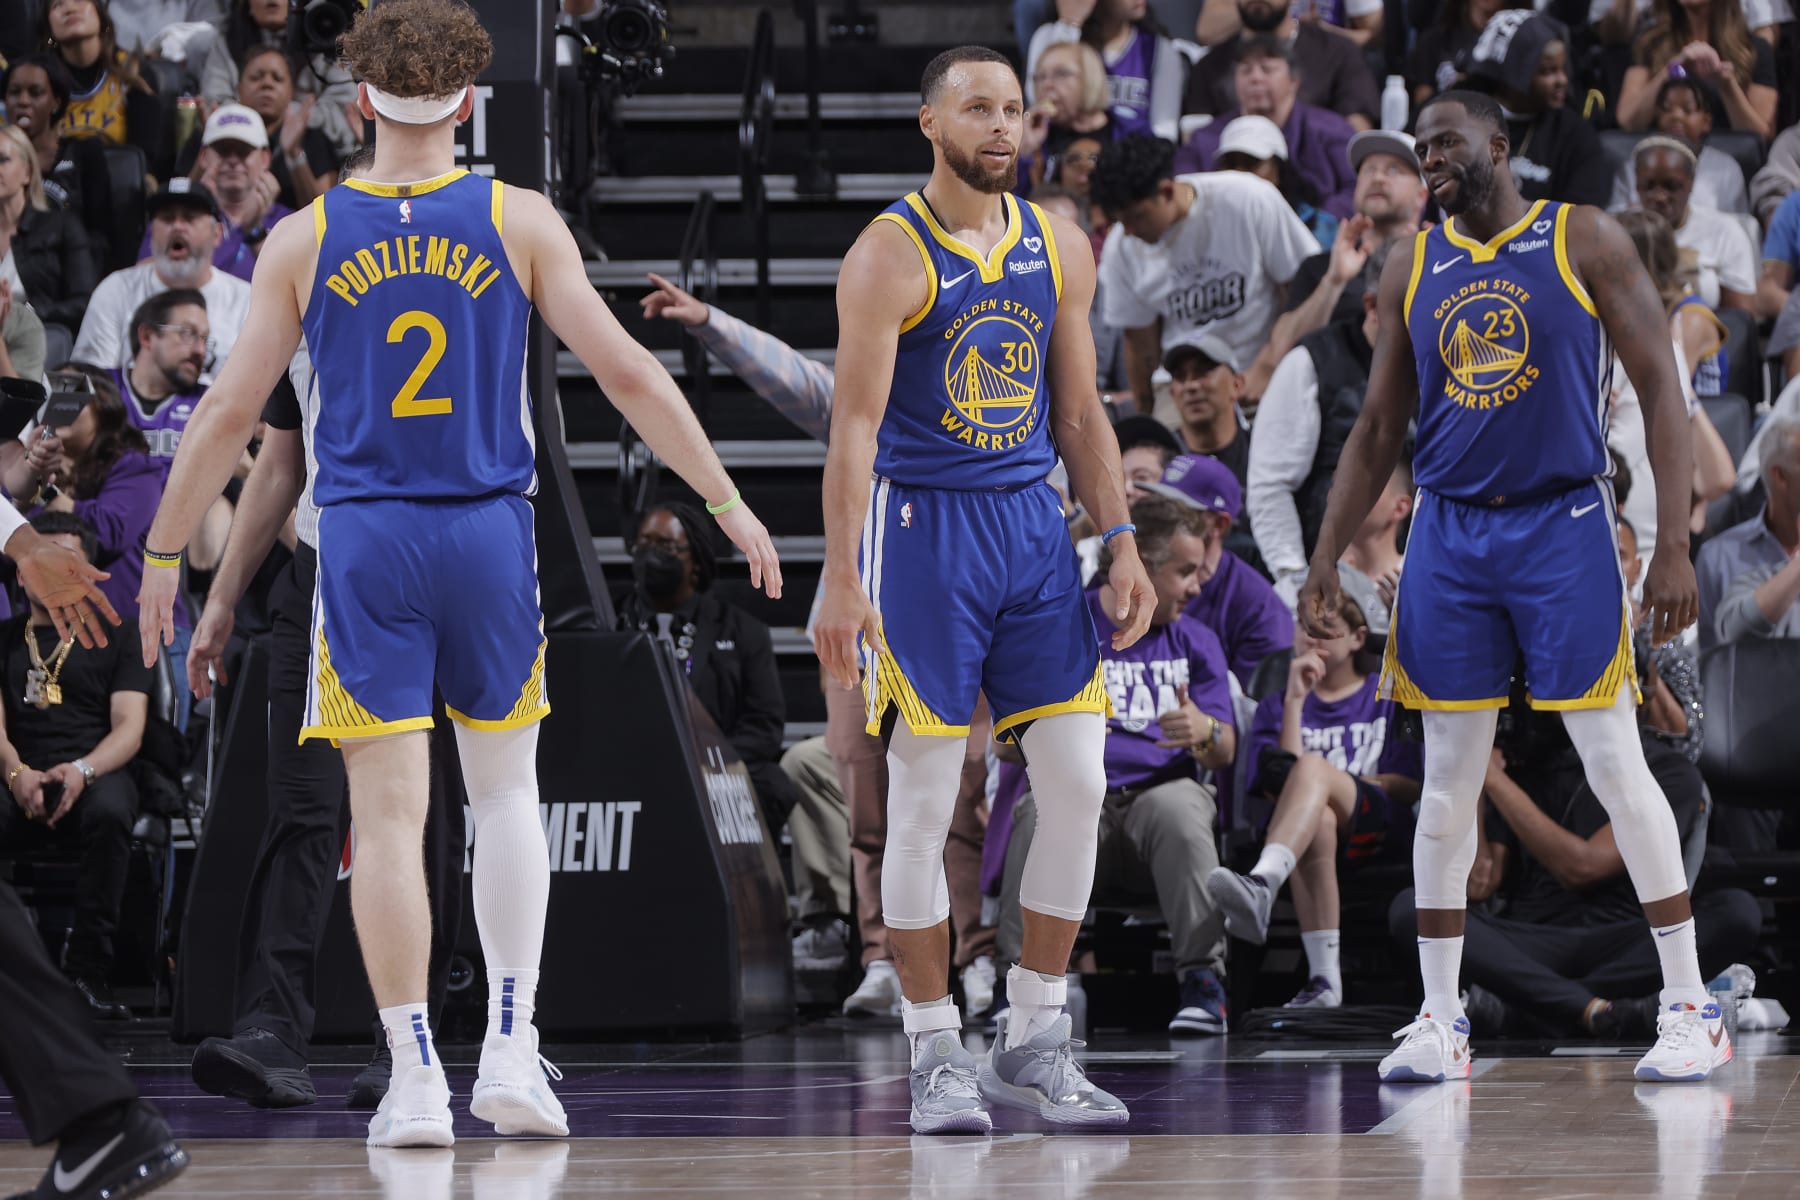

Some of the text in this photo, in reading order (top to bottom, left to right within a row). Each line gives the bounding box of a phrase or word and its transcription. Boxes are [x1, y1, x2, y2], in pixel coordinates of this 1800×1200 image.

[1509, 239, 1549, 252] Rakuten
[325, 235, 501, 307] PODZIEMSKI
[1009, 259, 1047, 273] Rakuten
[1434, 279, 1530, 319] GOLDEN STATE
[944, 299, 1044, 340] GOLDEN STATE
[1483, 308, 1516, 340] 23
[386, 310, 453, 418] 2
[1000, 341, 1033, 373] 30
[1443, 364, 1540, 411] WARRIORS
